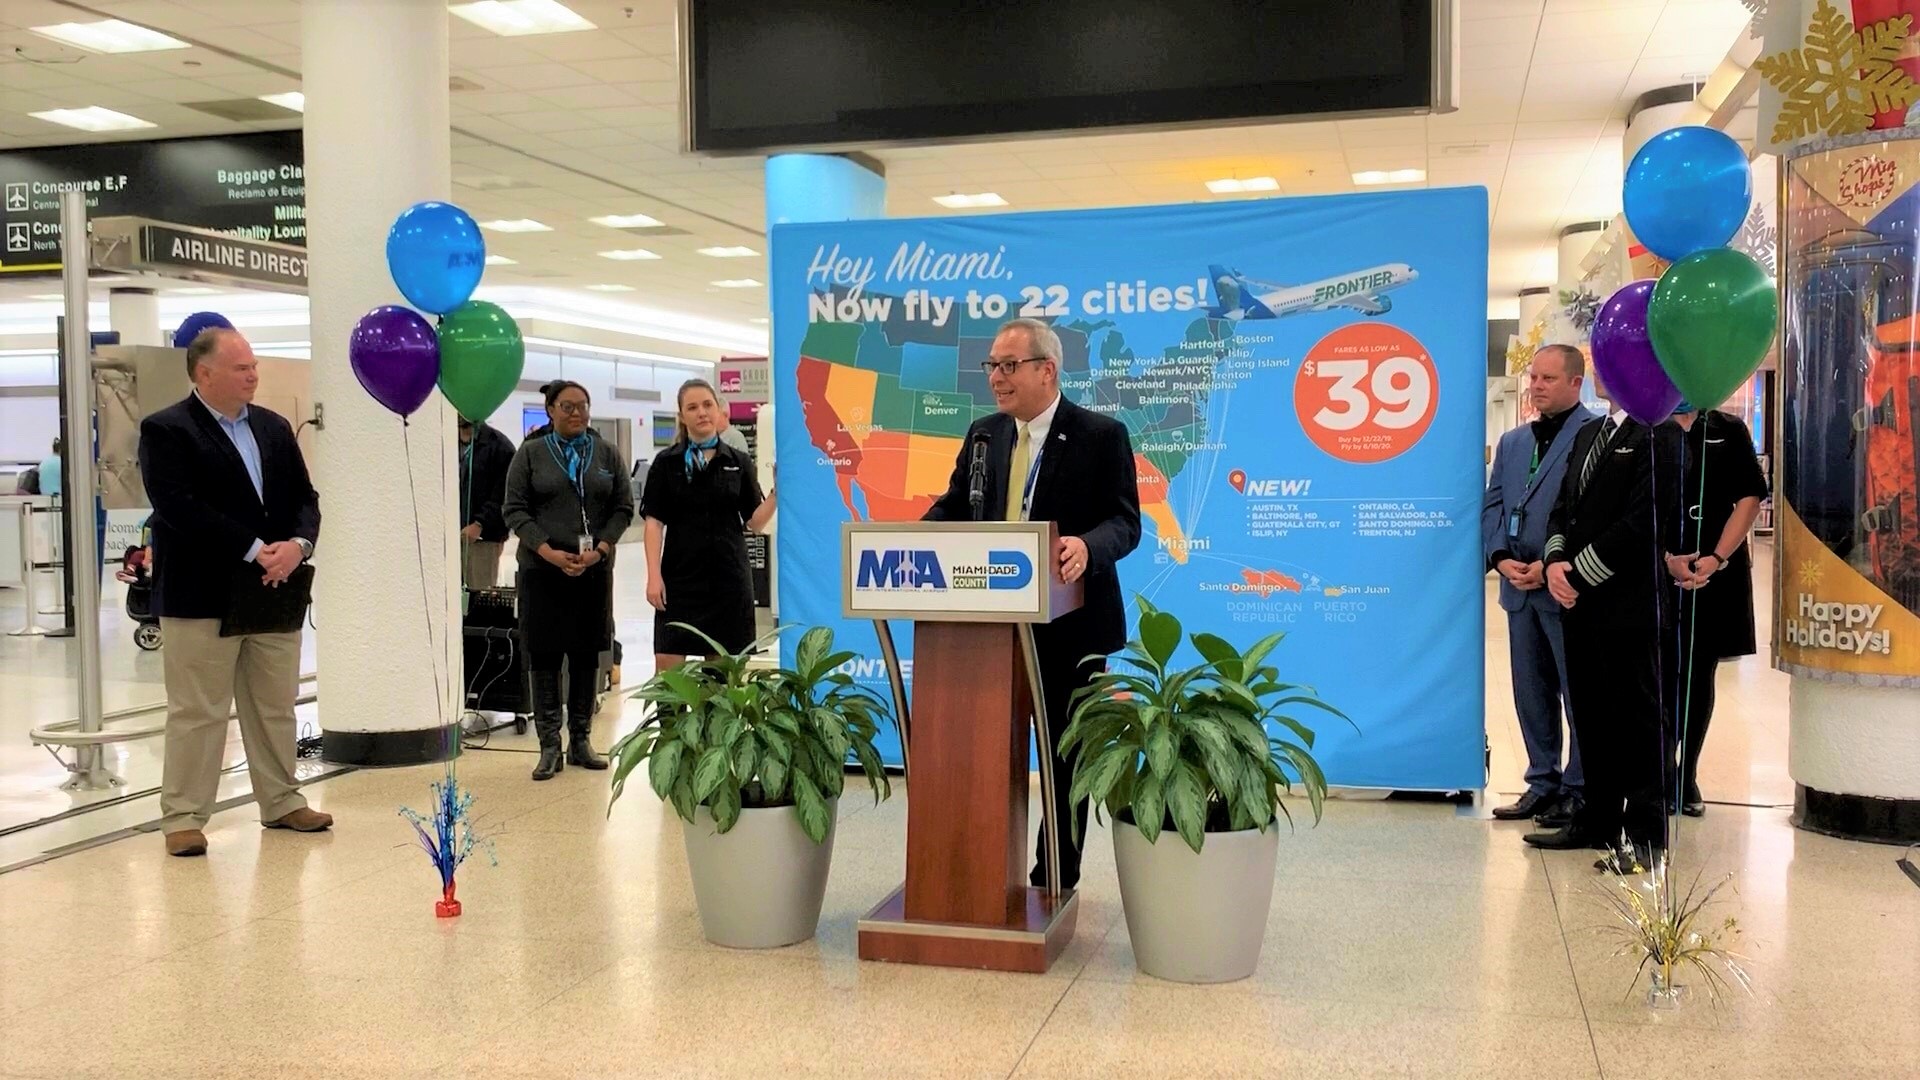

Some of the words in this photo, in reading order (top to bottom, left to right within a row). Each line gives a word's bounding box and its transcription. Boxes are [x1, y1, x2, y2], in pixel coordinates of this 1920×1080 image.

[217, 168, 276, 185] Baggage
[280, 163, 305, 180] Cla
[32, 180, 101, 194] Concourse
[105, 175, 128, 192] E,F
[228, 187, 266, 199] Reclamo
[268, 188, 279, 197] de
[281, 185, 306, 198] Equip
[1837, 178, 1885, 206] Shops
[33, 200, 60, 210] Centra
[274, 205, 306, 220] Milit
[274, 224, 307, 239] Loun
[33, 240, 57, 251] North
[171, 237, 246, 268] AIRLINE
[249, 250, 309, 278] DIRECT
[806, 243, 877, 300] Hey
[1313, 270, 1393, 303] FRONTIER
[808, 293, 893, 323] Now
[903, 289, 955, 327] fly
[966, 289, 1008, 319] to
[1019, 284, 1070, 317] 22
[1082, 278, 1208, 315] cities!
[1180, 340, 1225, 350] Hartford
[1236, 335, 1274, 344] Boston
[1334, 346, 1357, 354] FARES
[1109, 358, 1131, 367] New
[1177, 355, 1218, 365] Guardia
[1228, 360, 1255, 370] Long
[1258, 358, 1290, 368] Island
[1091, 368, 1126, 377] Detroit
[1143, 366, 1210, 376] Newark/NYC
[1211, 371, 1252, 379] Trenton
[1115, 380, 1165, 389] Cleveland
[1173, 380, 1237, 391] Philadelphia
[1139, 396, 1189, 405] Baltimore
[925, 406, 959, 415] Denver
[837, 424, 852, 432] Las
[1142, 442, 1227, 453] Raleigh/Durham
[817, 456, 852, 466] Ontario
[1247, 479, 1312, 497] NEW!
[1252, 512, 1303, 520] BALTIMORE,
[1378, 511, 1428, 519] SALVADOR,
[1358, 520, 1388, 528] SANTO
[1390, 520, 1436, 528] DOMINGO,
[1157, 536, 1210, 550] Miami
[856, 549, 948, 588] MIA
[953, 577, 987, 588] COUNTY
[1199, 582, 1230, 591] Santo
[1231, 582, 1281, 593] Domingo
[1340, 585, 1361, 594] San
[1364, 585, 1390, 594] Juan
[1226, 601, 1302, 612] DOMINICAN
[1314, 601, 1367, 612] PUERTO
[1799, 593, 1884, 628] Happy
[1232, 612, 1296, 623] REPUBLIC
[1324, 612, 1357, 622] RICO
[1786, 619, 1890, 655] Holidays!
